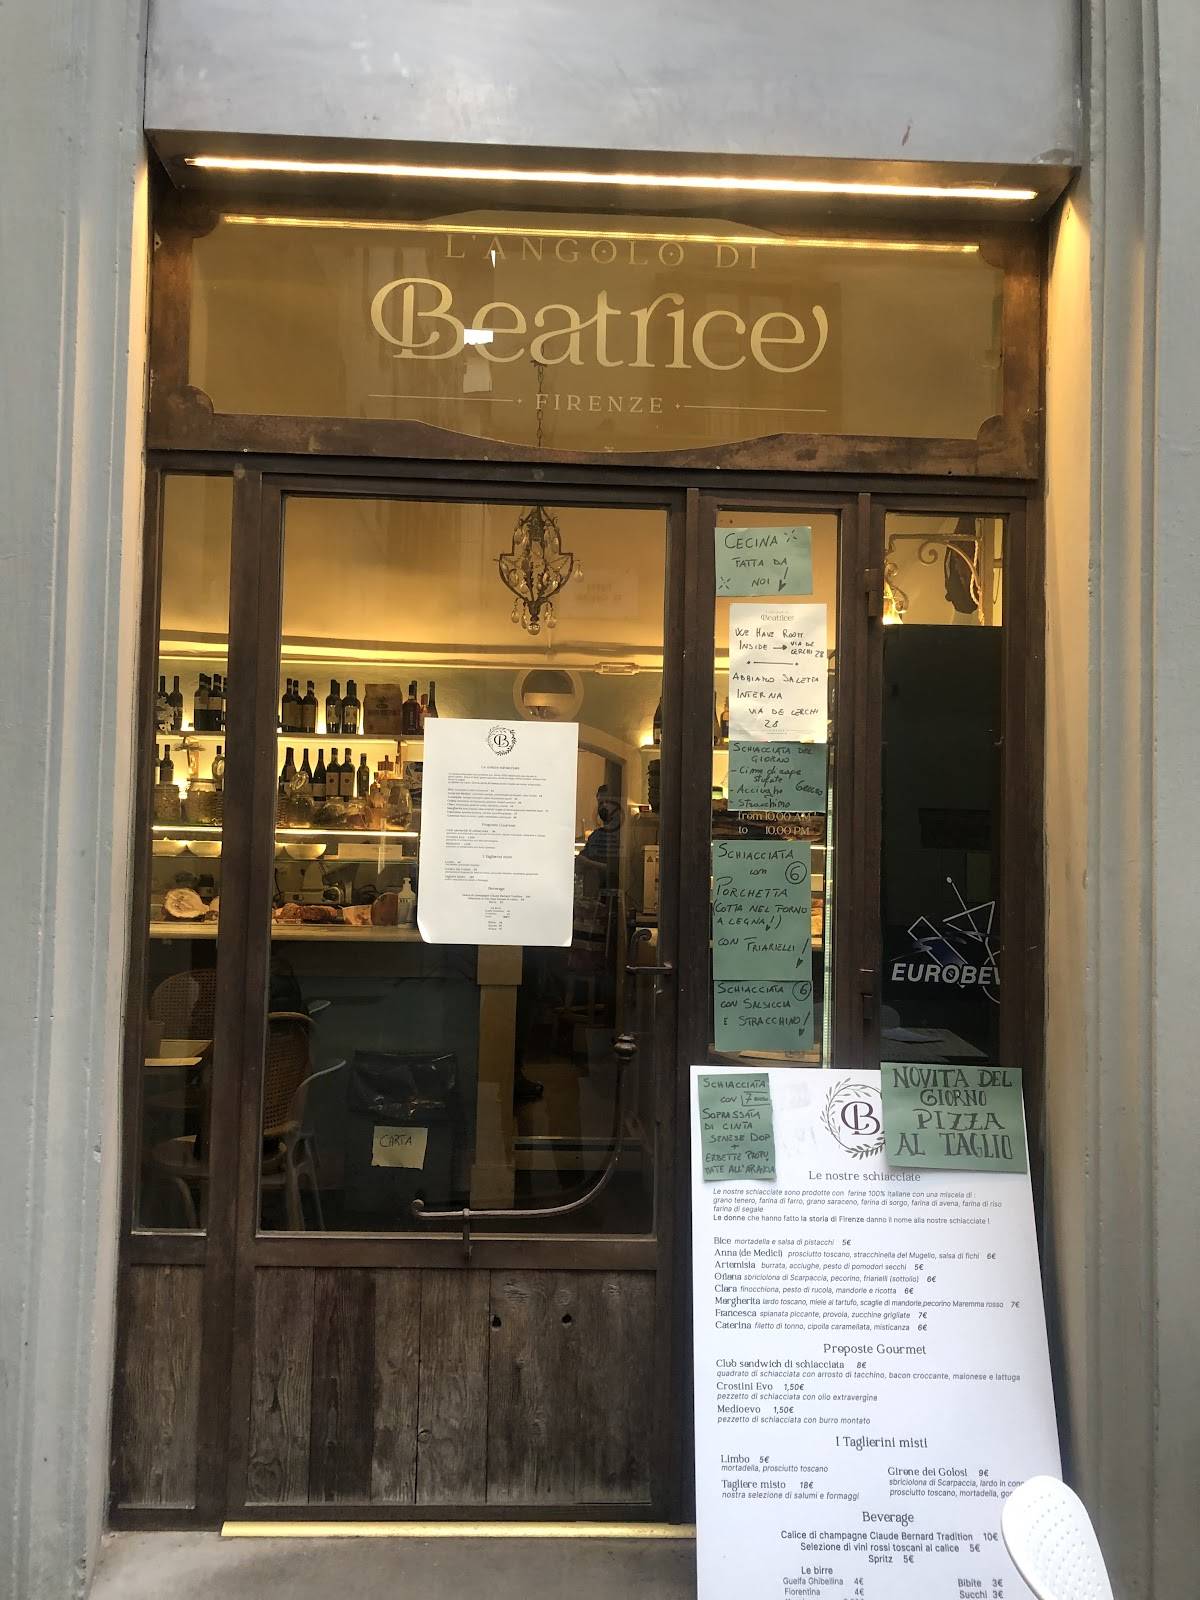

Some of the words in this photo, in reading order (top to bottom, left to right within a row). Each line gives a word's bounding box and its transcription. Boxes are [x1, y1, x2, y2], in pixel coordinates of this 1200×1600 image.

[444, 233, 686, 268] L'ANGOLO
[714, 243, 759, 270] DI
[370, 276, 829, 374] Beatrice
[534, 393, 664, 415] FIRENZE
[724, 532, 778, 549] CECINA
[731, 557, 764, 567] FATTA
[772, 557, 788, 566] DA
[755, 628, 775, 638] HAVE
[739, 640, 768, 650] INSIDE
[737, 688, 783, 699] INTERNA
[738, 826, 749, 834] to
[793, 826, 810, 835] PM
[718, 843, 794, 860] SCHIACCIATA
[716, 876, 789, 898] PORCHETTA
[749, 905, 770, 913] NEL
[775, 904, 808, 914] FORNO
[717, 982, 784, 994] SCHIACCIATA
[743, 998, 791, 1009] SALSICCIA
[723, 1017, 728, 1026] E
[703, 1078, 766, 1089] SCHIACCIATA
[977, 1069, 1013, 1088] DEL
[919, 1088, 987, 1107] GIORNO
[912, 1108, 1006, 1131] PIZZA
[722, 1121, 753, 1130] CINTA
[379, 1134, 413, 1148] CARTA
[750, 1132, 771, 1142] DOP
[894, 1132, 926, 1156] AL
[938, 1133, 1013, 1160] TAGLIO
[809, 1170, 821, 1179] Le
[826, 1172, 858, 1180] nostre
[863, 1170, 920, 1181] schiacciate
[823, 1343, 872, 1356] Proposte
[876, 1344, 925, 1354] Gourmet
[835, 1435, 840, 1446] I
[842, 1436, 896, 1451] Taglierini
[898, 1437, 927, 1448] misti
[862, 1511, 914, 1527] Beverage
[780, 1530, 806, 1539] Calice
[808, 1530, 817, 1539] di
[818, 1532, 868, 1541] champagne
[869, 1531, 899, 1540] Claude
[900, 1531, 934, 1540] Bernard
[935, 1532, 973, 1540] Tradition
[800, 1542, 841, 1550] Selezione
[843, 1542, 851, 1551] di
[853, 1542, 868, 1551] vini
[870, 1542, 890, 1551] rossi
[892, 1543, 922, 1551] toscani
[925, 1543, 932, 1552] al
[934, 1543, 959, 1552] calice
[868, 1554, 893, 1564] Spritz
[801, 1566, 810, 1574] Le
[814, 1565, 832, 1574] birre
[959, 1590, 988, 1598] Succhi
